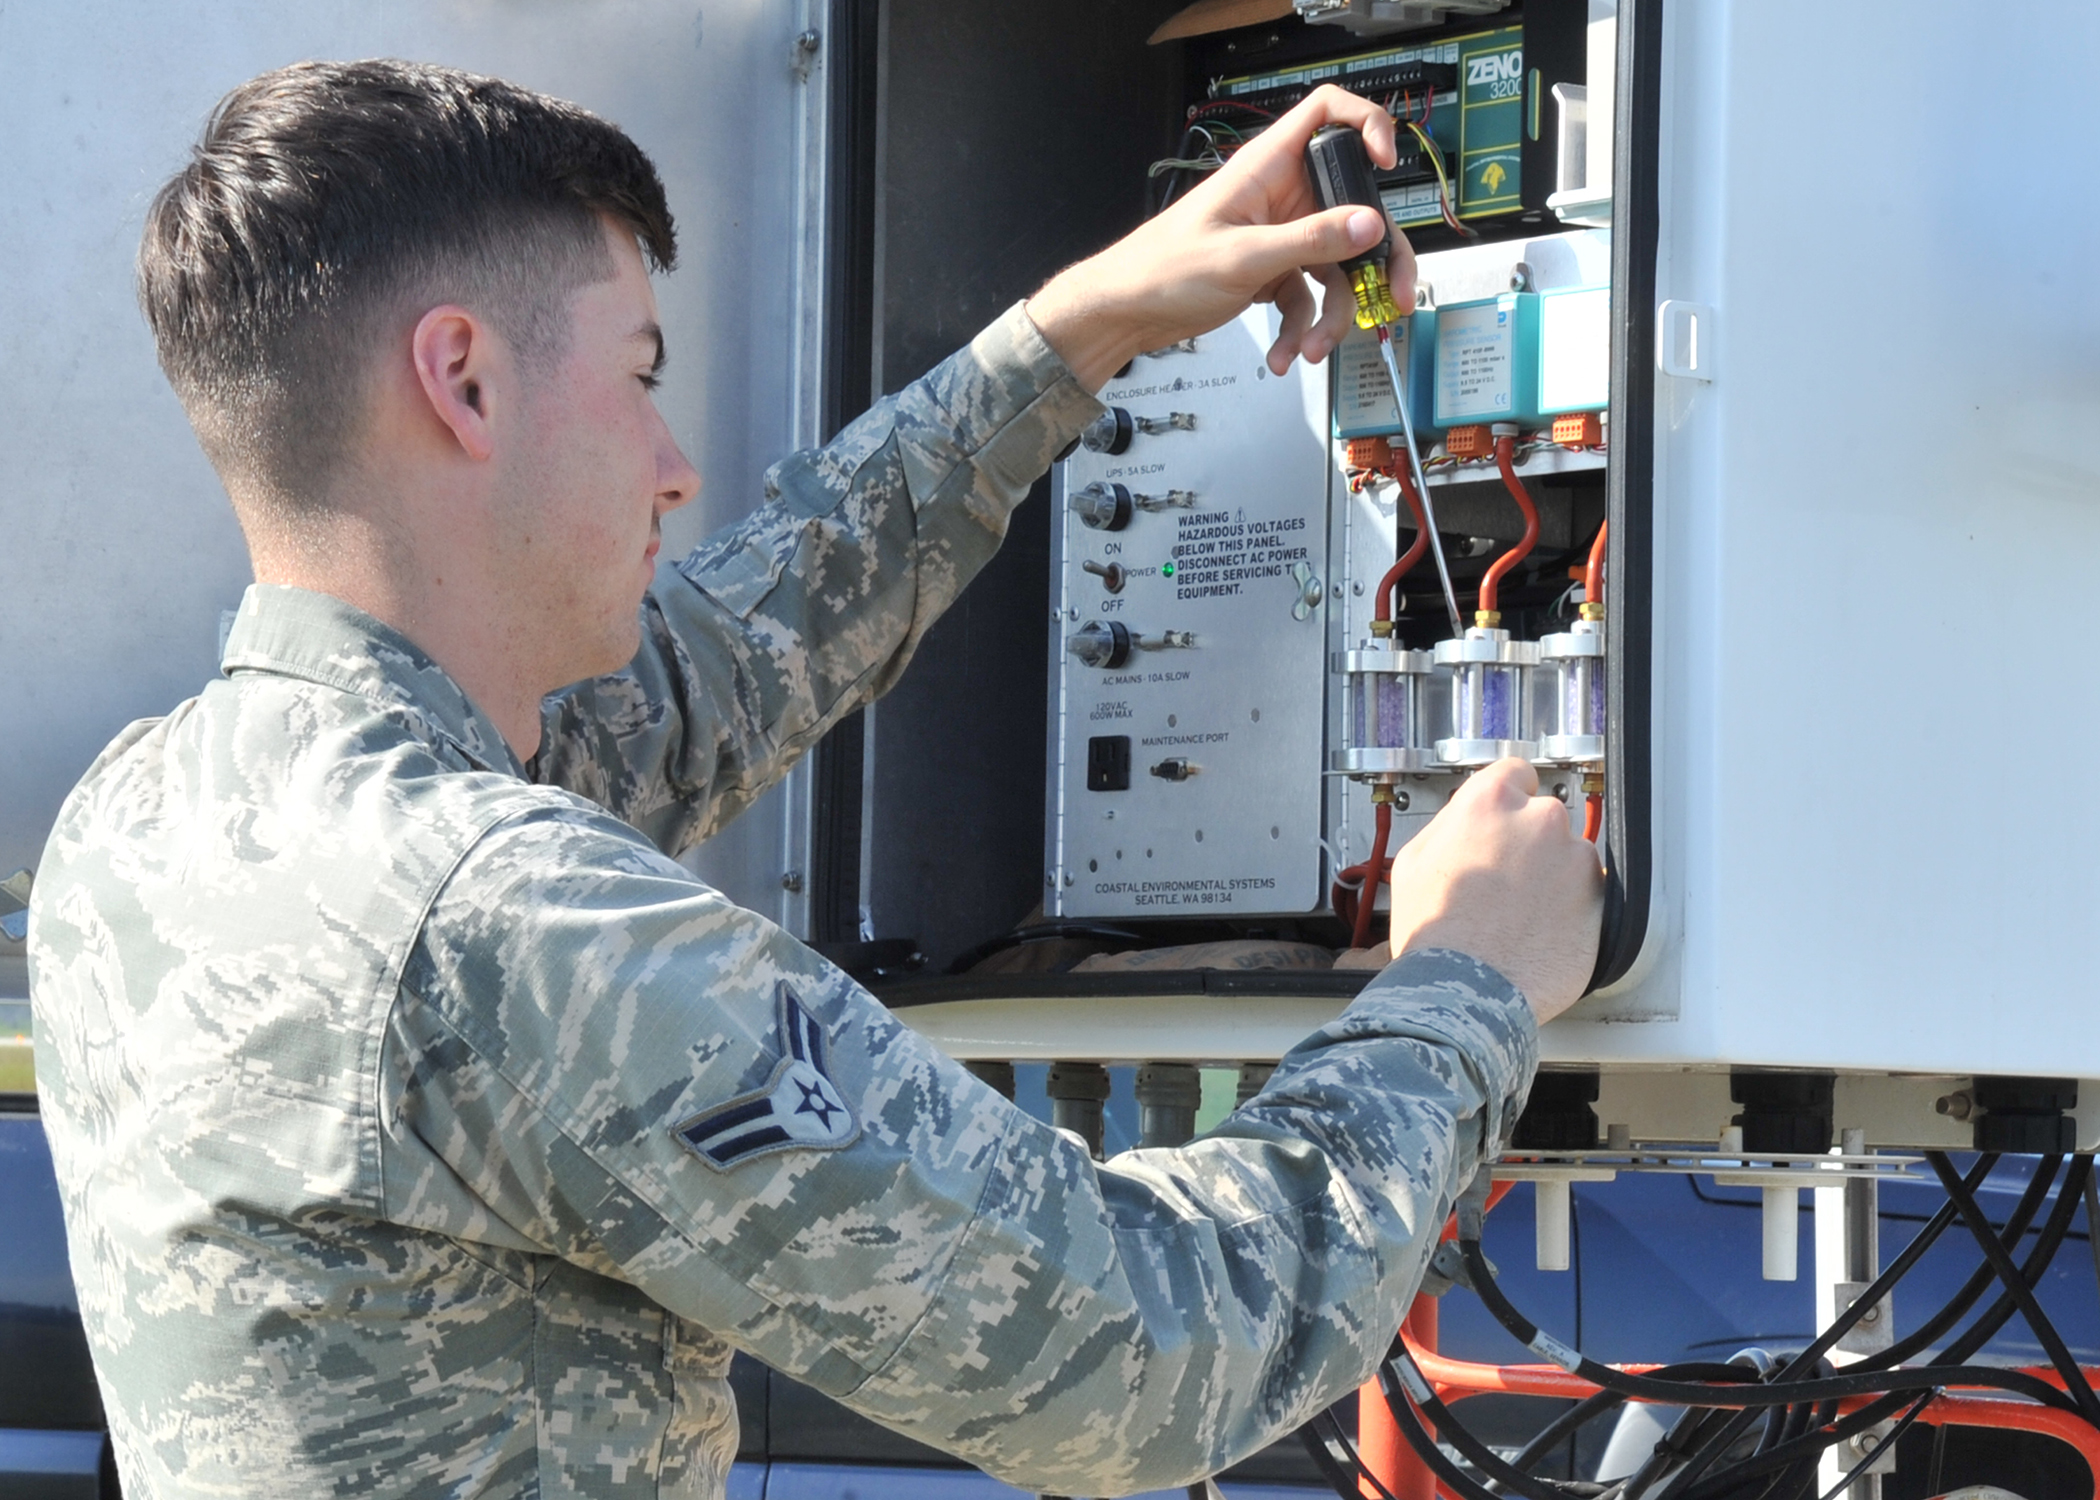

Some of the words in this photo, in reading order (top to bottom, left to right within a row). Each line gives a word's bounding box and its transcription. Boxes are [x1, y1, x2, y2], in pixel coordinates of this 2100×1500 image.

[1467, 51, 1522, 86] ZENO
[1106, 385, 1158, 401] ENCLOSURE
[1198, 379, 1210, 389] 3A
[1211, 375, 1238, 387] SLOW
[1106, 467, 1123, 478] UPS
[1128, 465, 1139, 476] 5A
[1140, 463, 1166, 475] SLOW
[1178, 510, 1229, 528] WARNING
[1178, 525, 1244, 542] HAZARDOUS
[1247, 517, 1306, 535] VOLTAGES
[1104, 543, 1122, 555] ON
[1178, 541, 1216, 557] BELOW
[1218, 538, 1244, 553] THIS
[1246, 535, 1286, 550] PANEL.
[1178, 554, 1248, 572] DISCONNECT
[1249, 551, 1266, 564] AC
[1268, 547, 1308, 562] POWER
[1125, 566, 1157, 578] POWER
[1178, 570, 1220, 586] BEFORE
[1222, 564, 1282, 581] SERVICING
[1177, 583, 1243, 600] EQUIPMENT.
[1101, 599, 1125, 613] OFF
[1102, 676, 1114, 686] AC
[1115, 674, 1142, 685] MAINS
[1147, 672, 1164, 683] 10A
[1164, 671, 1190, 682] SLOW
[1095, 701, 1128, 712] 120VAC
[1090, 710, 1112, 721] 600W
[1113, 709, 1133, 720] MAX
[1141, 734, 1205, 747] MAINTENANCE
[1206, 732, 1229, 744] PORT
[1095, 881, 1140, 894] COASTAL
[1141, 879, 1227, 893] ENVIRONMENTAL
[1228, 877, 1276, 890] SYSTEMS
[1182, 893, 1199, 905] WA
[1200, 892, 1232, 905] 98134
